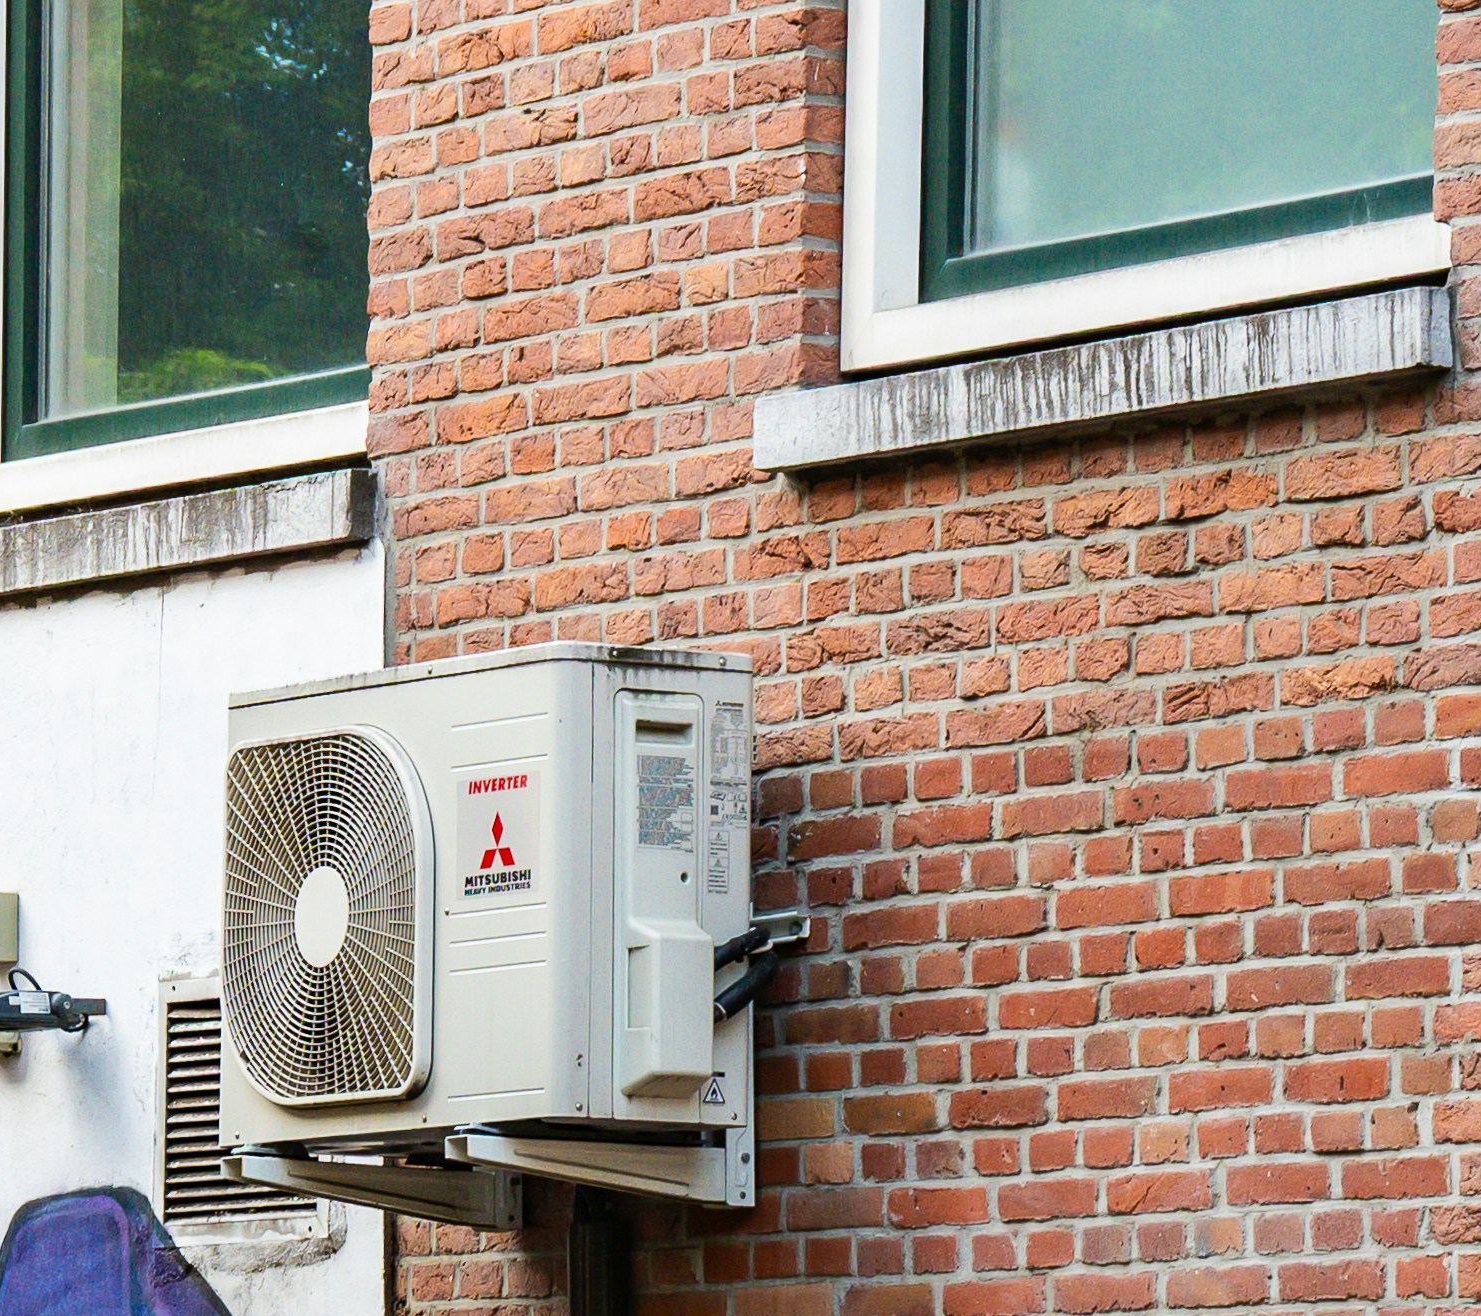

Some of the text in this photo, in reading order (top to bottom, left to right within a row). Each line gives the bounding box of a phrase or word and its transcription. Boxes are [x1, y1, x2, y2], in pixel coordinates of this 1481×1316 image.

[468, 774, 528, 795] INVERTER
[465, 869, 532, 888] MITSUBISHI
[464, 881, 531, 896] HEAVY INDUSTRIES
